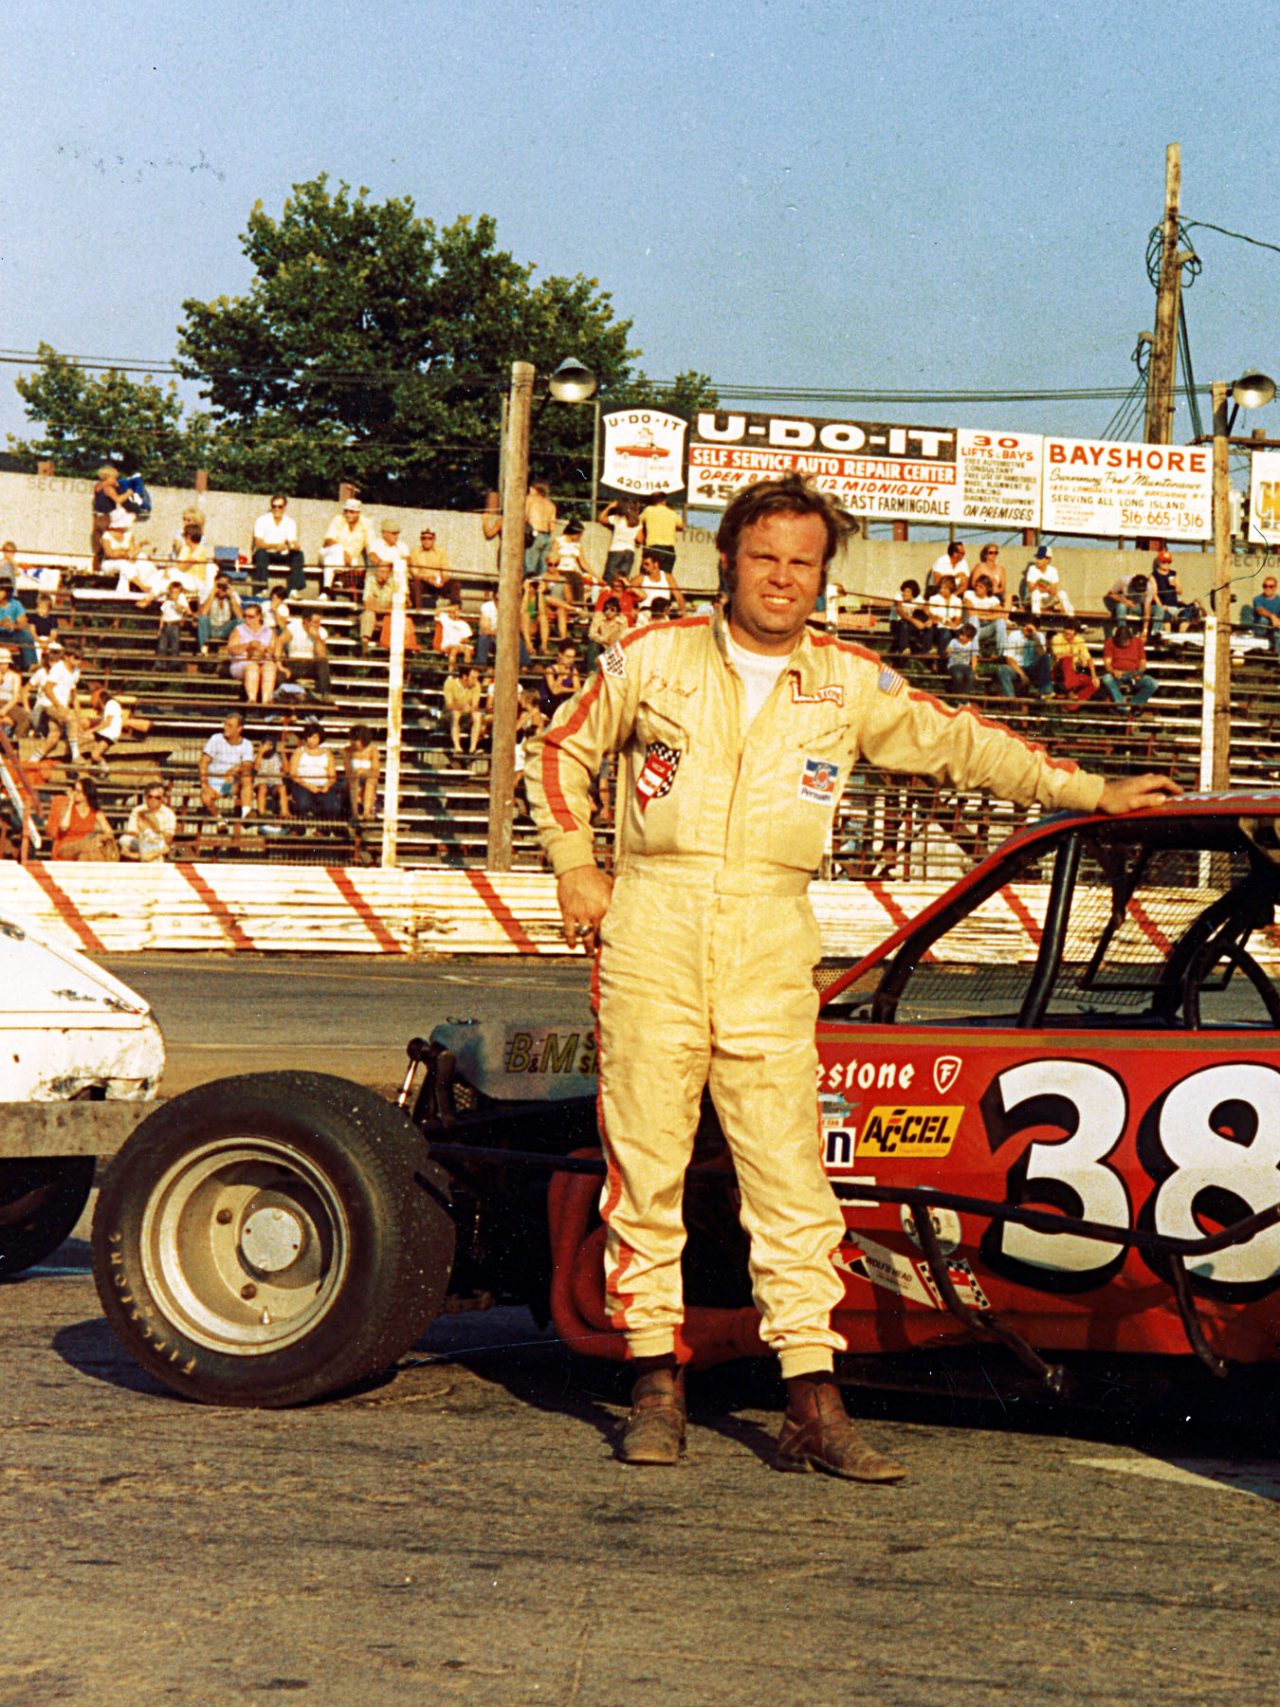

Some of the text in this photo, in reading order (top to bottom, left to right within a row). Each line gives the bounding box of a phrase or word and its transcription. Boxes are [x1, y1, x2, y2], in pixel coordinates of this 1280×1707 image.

[697, 413, 953, 457] U-DO-IT
[693, 448, 728, 466] SELF
[731, 451, 793, 471] SERVICE
[796, 456, 839, 475] AUTO
[844, 460, 901, 480] REPAIR
[903, 464, 954, 483] CENTER
[961, 447, 993, 459] LIFTS
[1002, 449, 1034, 461] BAYS
[1049, 444, 1206, 473] BAYSHORE
[26, 476, 88, 494] SECTIO
[700, 469, 743, 483] OPEN
[821, 479, 838, 490] 12
[842, 481, 939, 497] MIDNIGHT
[842, 494, 951, 515] EAST FARMINGDALE
[963, 504, 1035, 521] ON PREMISES
[1052, 493, 1186, 511] SERVING ALL LONG ISLAND
[816, 1059, 915, 1089] estone
[863, 1109, 950, 1153] ACCEL
